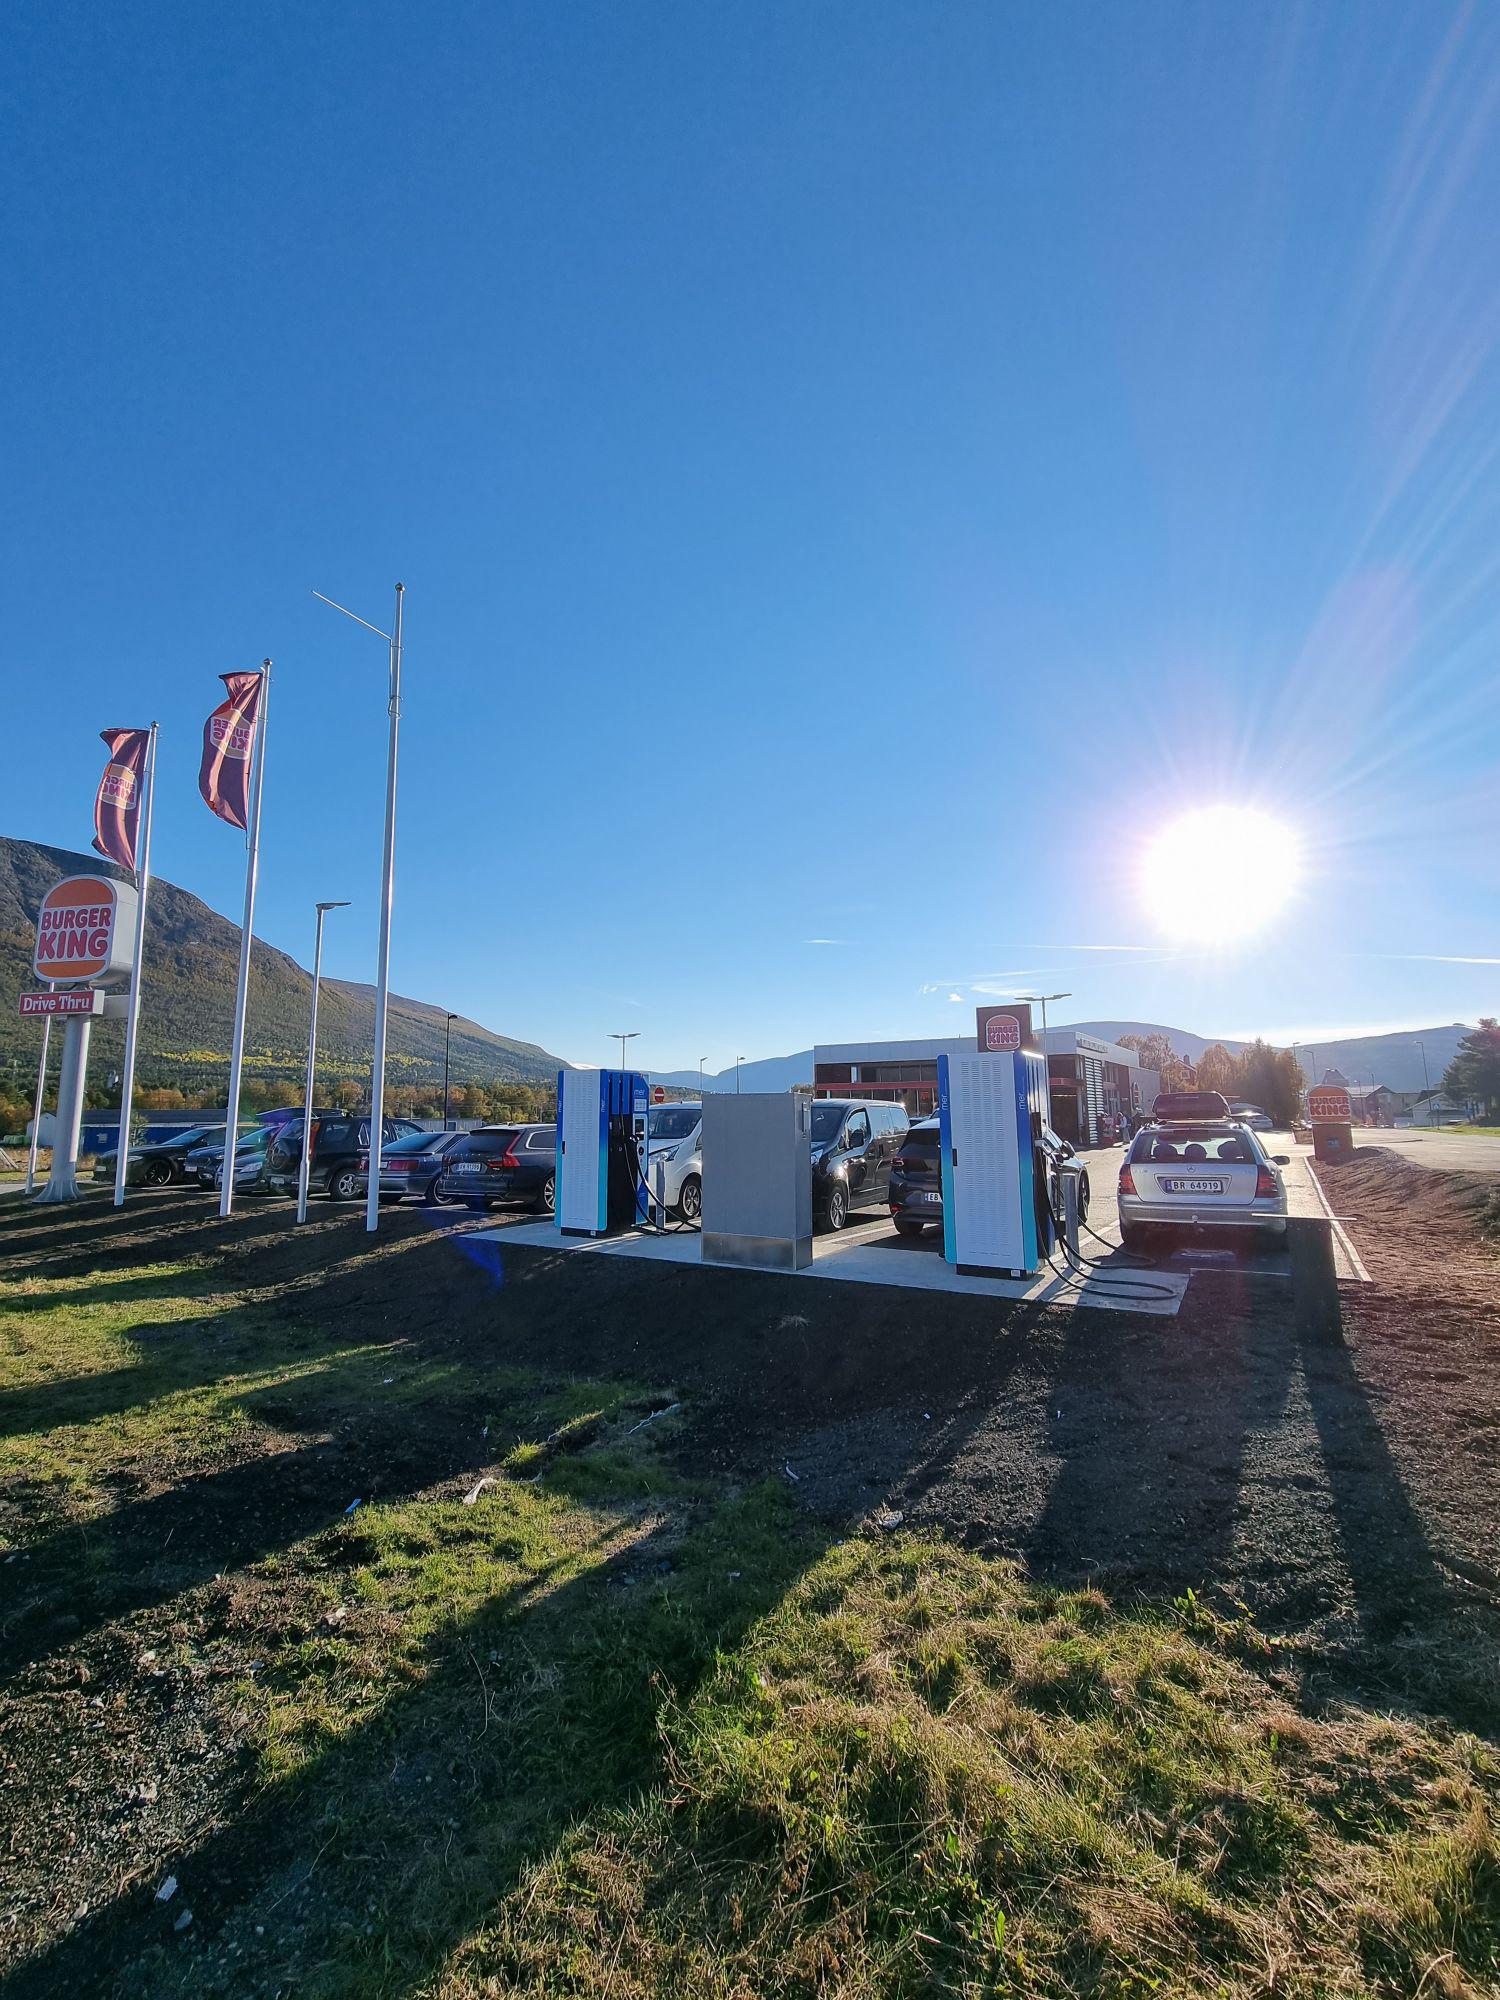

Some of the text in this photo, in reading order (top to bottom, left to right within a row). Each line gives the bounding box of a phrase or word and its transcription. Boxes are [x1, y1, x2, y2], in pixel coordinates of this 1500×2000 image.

[41, 907, 112, 931] BURGER
[37, 928, 109, 960] KING
[23, 996, 90, 1012] Drive Thru
[987, 1026, 1019, 1034] BURGER
[987, 1032, 1019, 1044] KING
[1309, 1096, 1349, 1105] BURGER
[1309, 1104, 1350, 1116] KING
[1173, 1181, 1219, 1190] BR 64919
